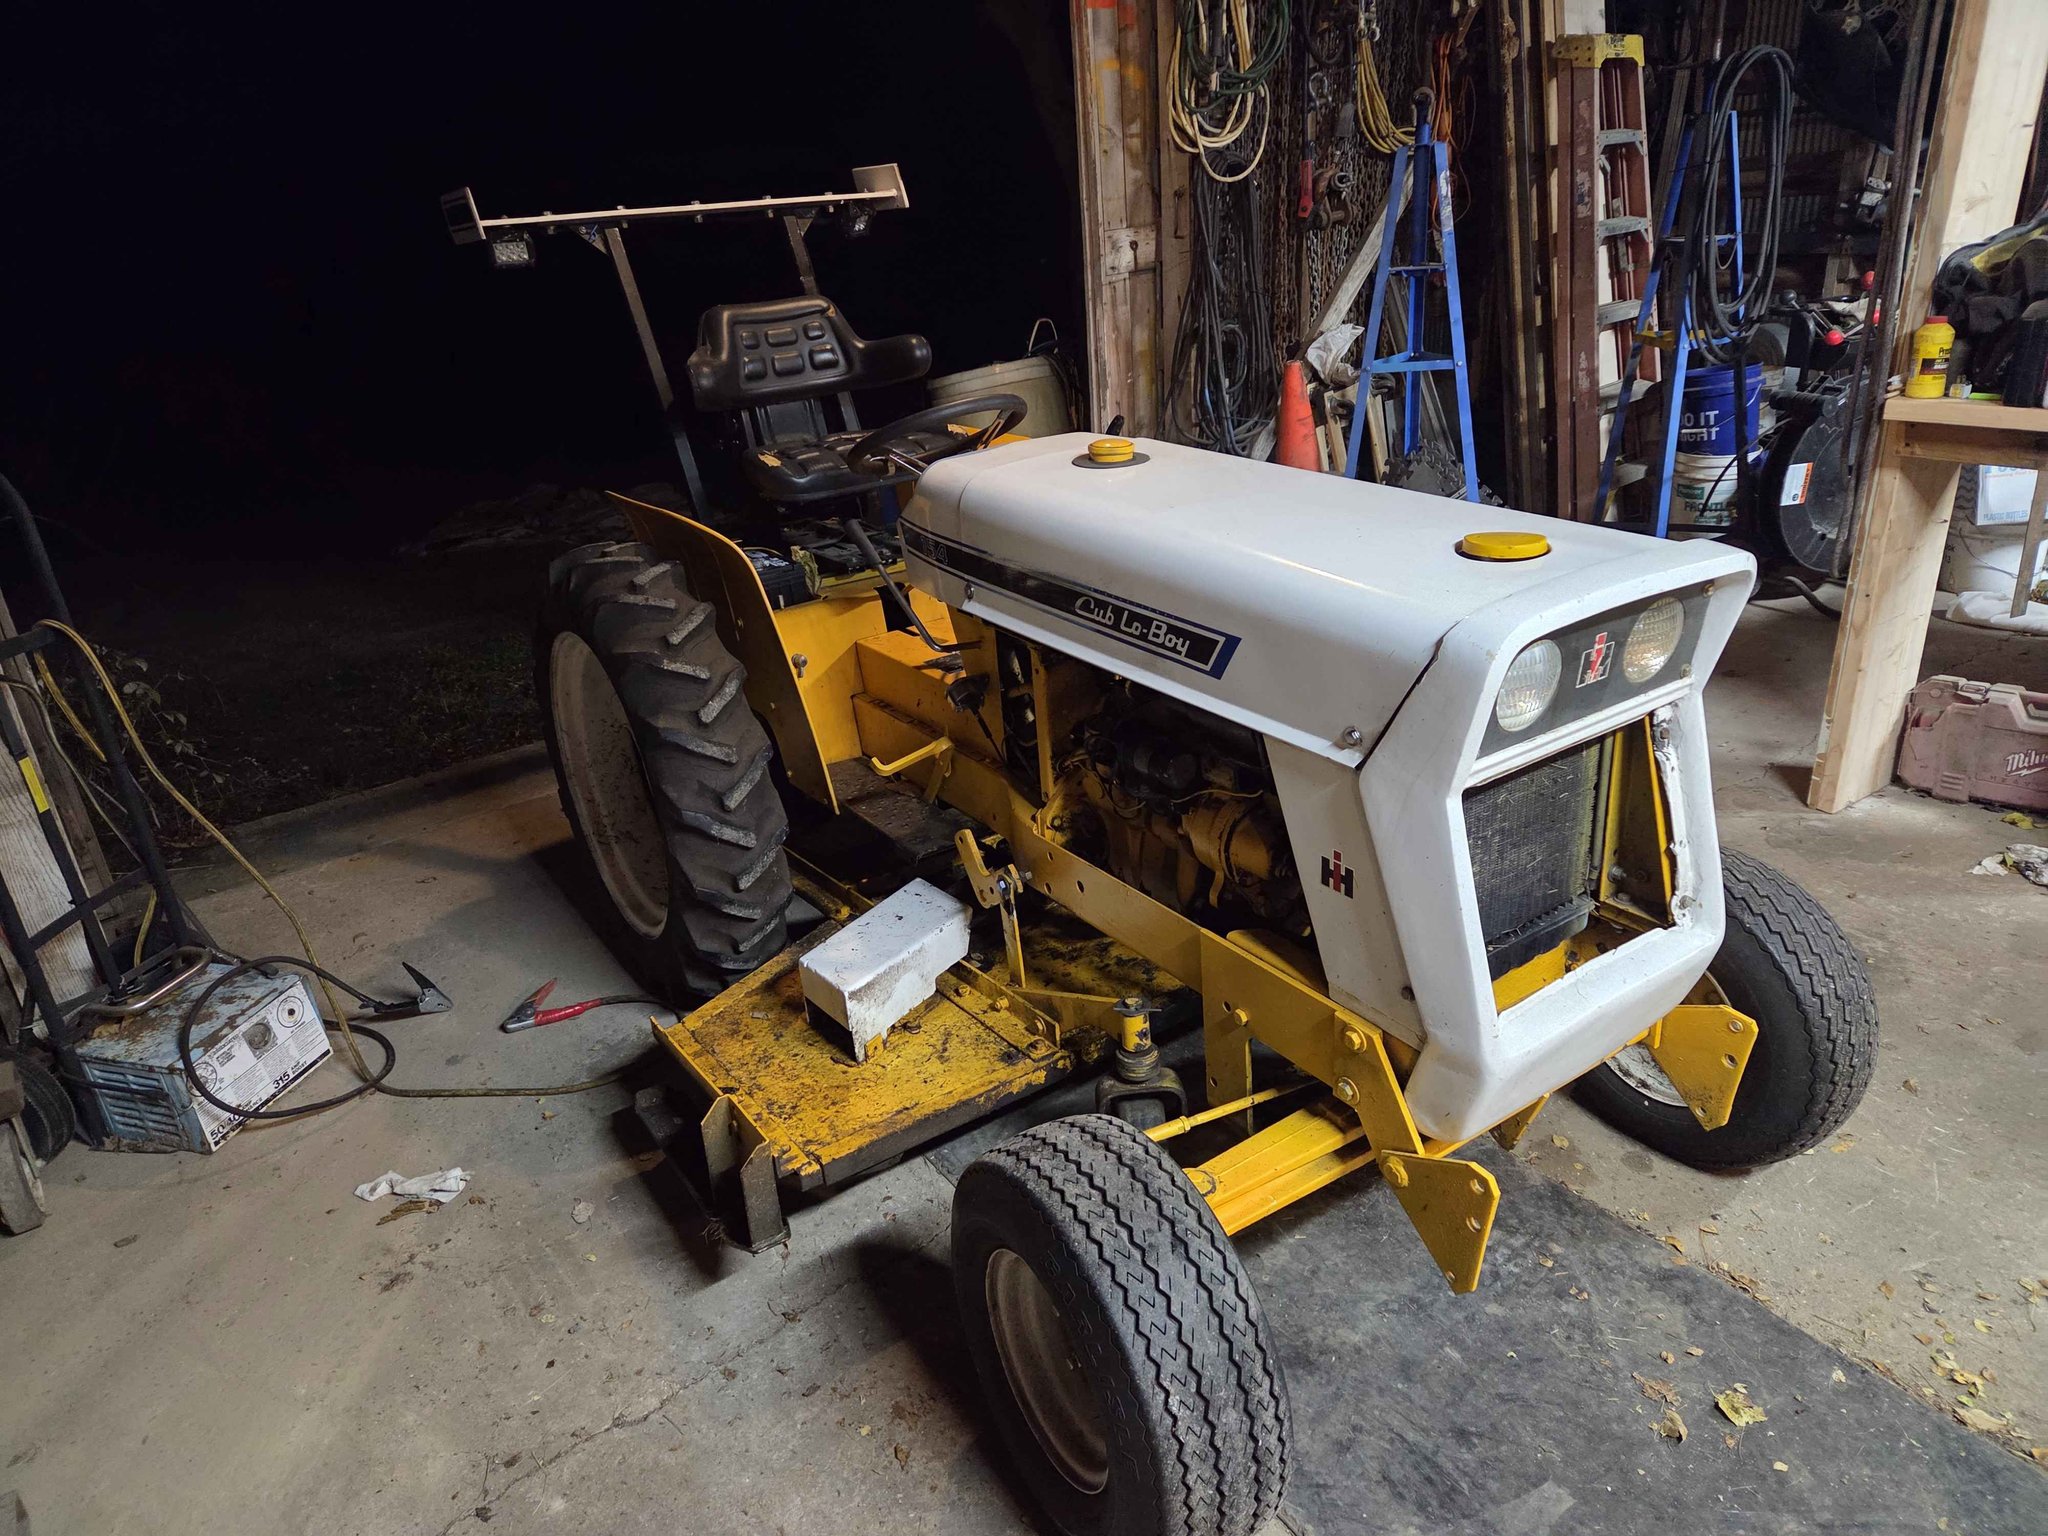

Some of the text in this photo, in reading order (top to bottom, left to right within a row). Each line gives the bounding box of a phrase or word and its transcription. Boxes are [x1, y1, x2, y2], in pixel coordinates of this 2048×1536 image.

[1700, 410, 1719, 426] IT
[1074, 595, 1190, 657] Cub Lo-Boy
[272, 1071, 290, 1089] 315
